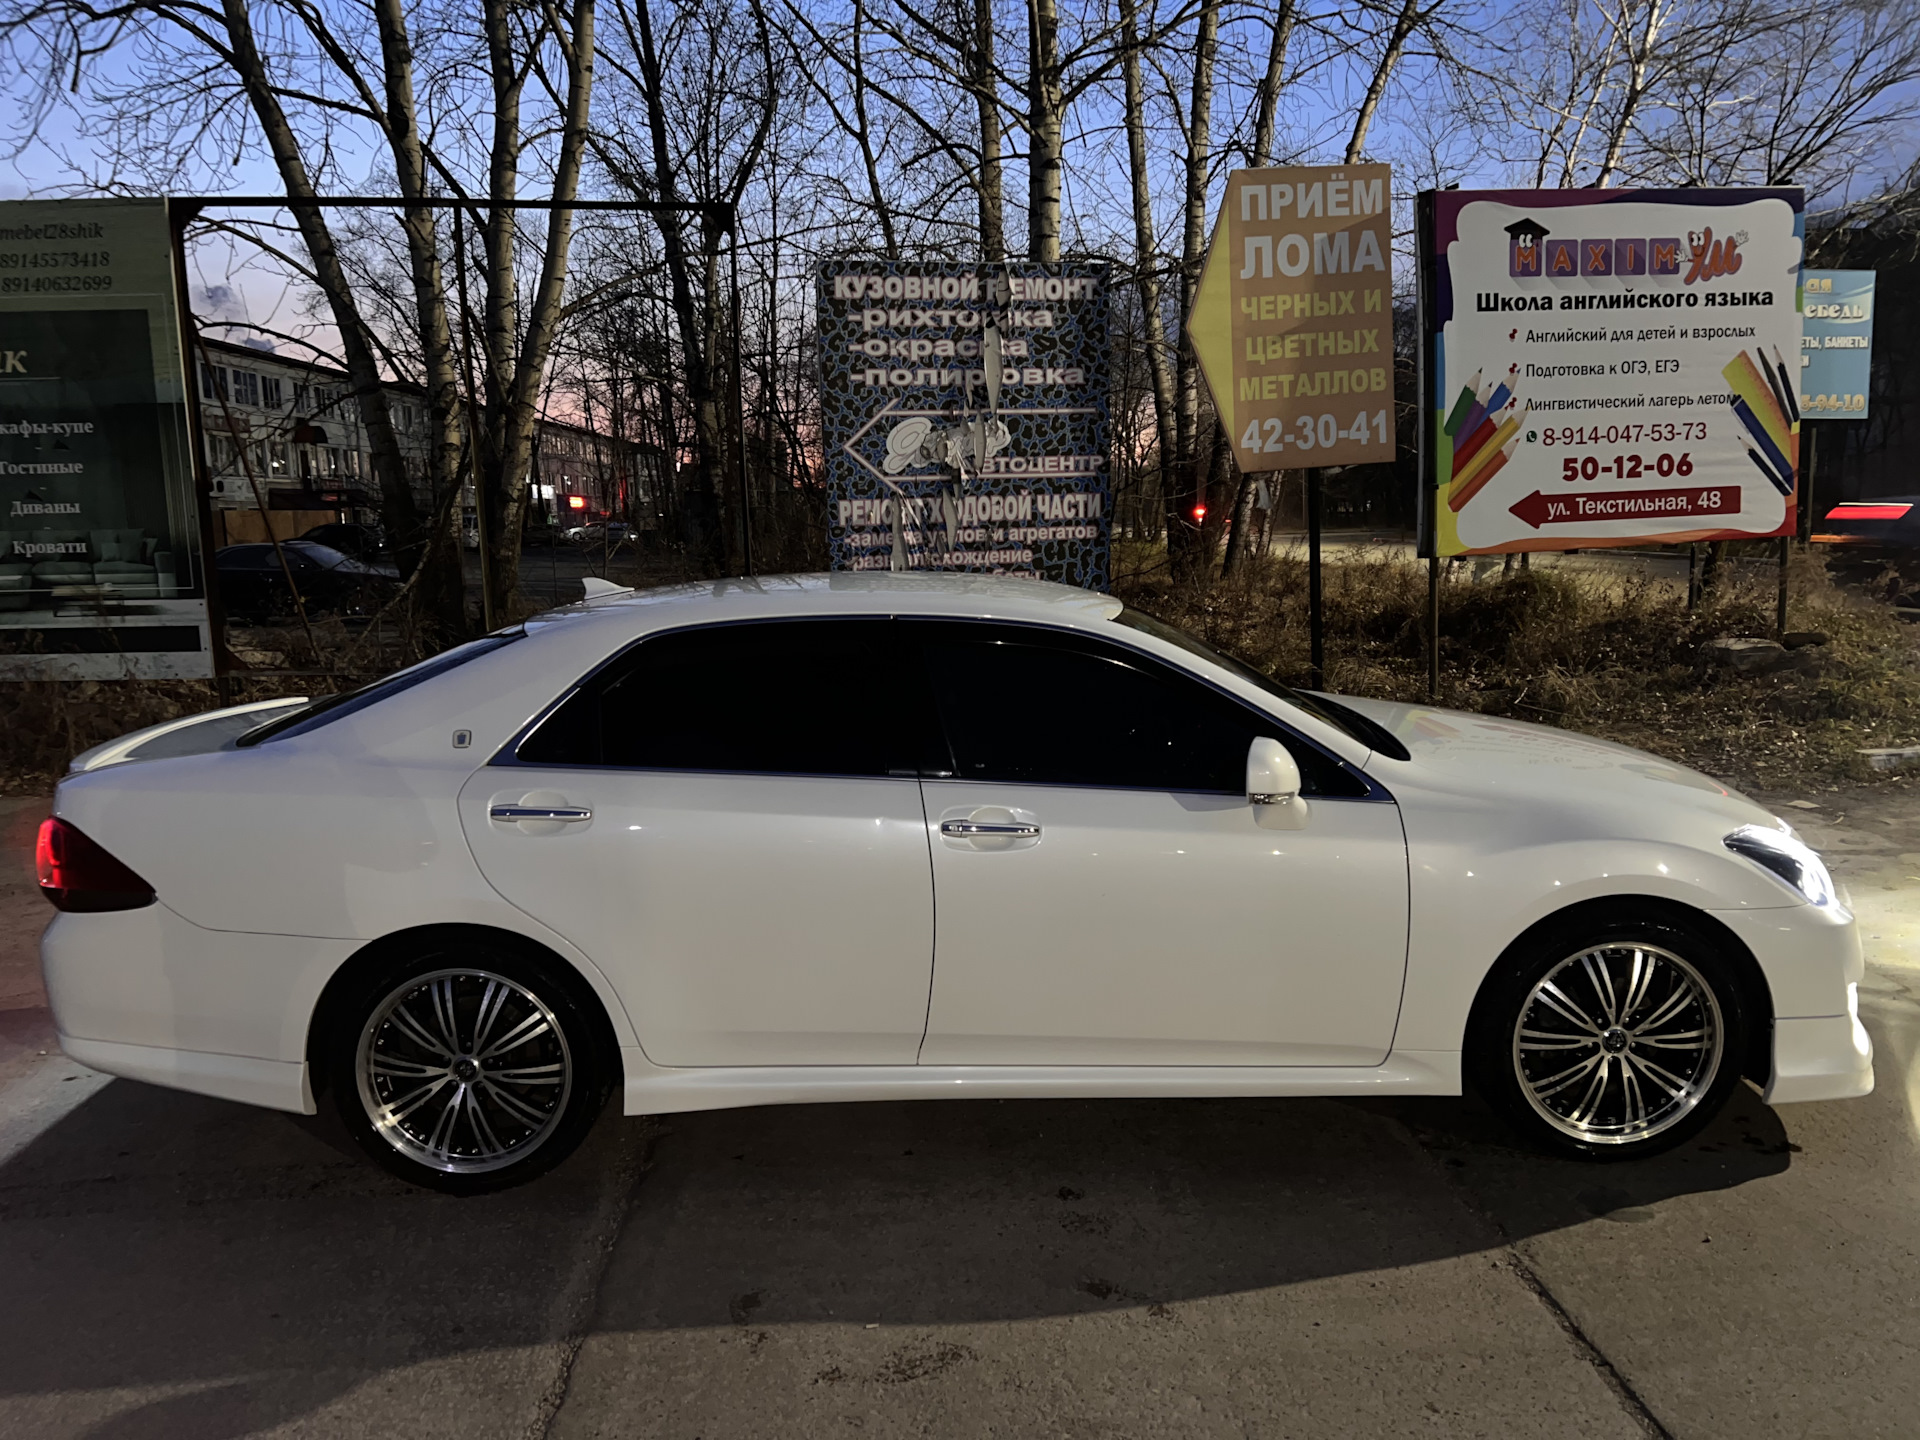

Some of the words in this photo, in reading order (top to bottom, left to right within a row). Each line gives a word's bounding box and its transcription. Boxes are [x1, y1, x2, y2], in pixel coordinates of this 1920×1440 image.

[1240, 172, 1384, 221] ПРИЁМ
[0, 251, 110, 268] 89145573418
[1239, 229, 1386, 280] ЛОМА
[1514, 242, 1676, 272] MAXIM
[2, 275, 113, 293] 89140632699
[834, 272, 979, 300] КУЗОВНОЙ
[1240, 290, 1355, 321] ЧЕРНЫХ
[1364, 288, 1382, 314] И
[1476, 290, 1553, 313] Школа
[1560, 288, 1699, 311] английского
[1704, 289, 1774, 309] языка
[848, 308, 1054, 331] -рихтока
[1245, 329, 1379, 365] ЦВЕТНЫХ
[1526, 327, 1607, 343] Английский
[1610, 329, 1634, 343] для
[1637, 327, 1676, 342] детей
[1680, 329, 1689, 339] и
[1692, 326, 1757, 341] взрослых
[850, 366, 1086, 389] -полировка
[1526, 362, 1605, 379] Подготовка
[1609, 364, 1618, 375] к
[1620, 360, 1651, 376] ОГЭ,
[1655, 359, 1680, 373] ЕГЭ
[1239, 367, 1387, 402] МЕТАЛЛОВ
[1525, 392, 1645, 411] Лингвистический
[1648, 393, 1694, 409] лагерь
[1697, 393, 1736, 406] летом
[1240, 408, 1388, 454] 42-30-41
[1542, 422, 1708, 447] 8-914-047-53-73
[0, 461, 84, 474] Гостиные
[1562, 452, 1694, 482] 50-12-06
[10, 501, 82, 518] Диваны
[1036, 493, 1101, 520] ЧАСТИ
[1547, 501, 1571, 521] ул.
[1575, 495, 1693, 516] Текстильная,
[1697, 490, 1722, 509] 48
[1008, 526, 1099, 545] агрегатов
[13, 541, 88, 558] Кровати
